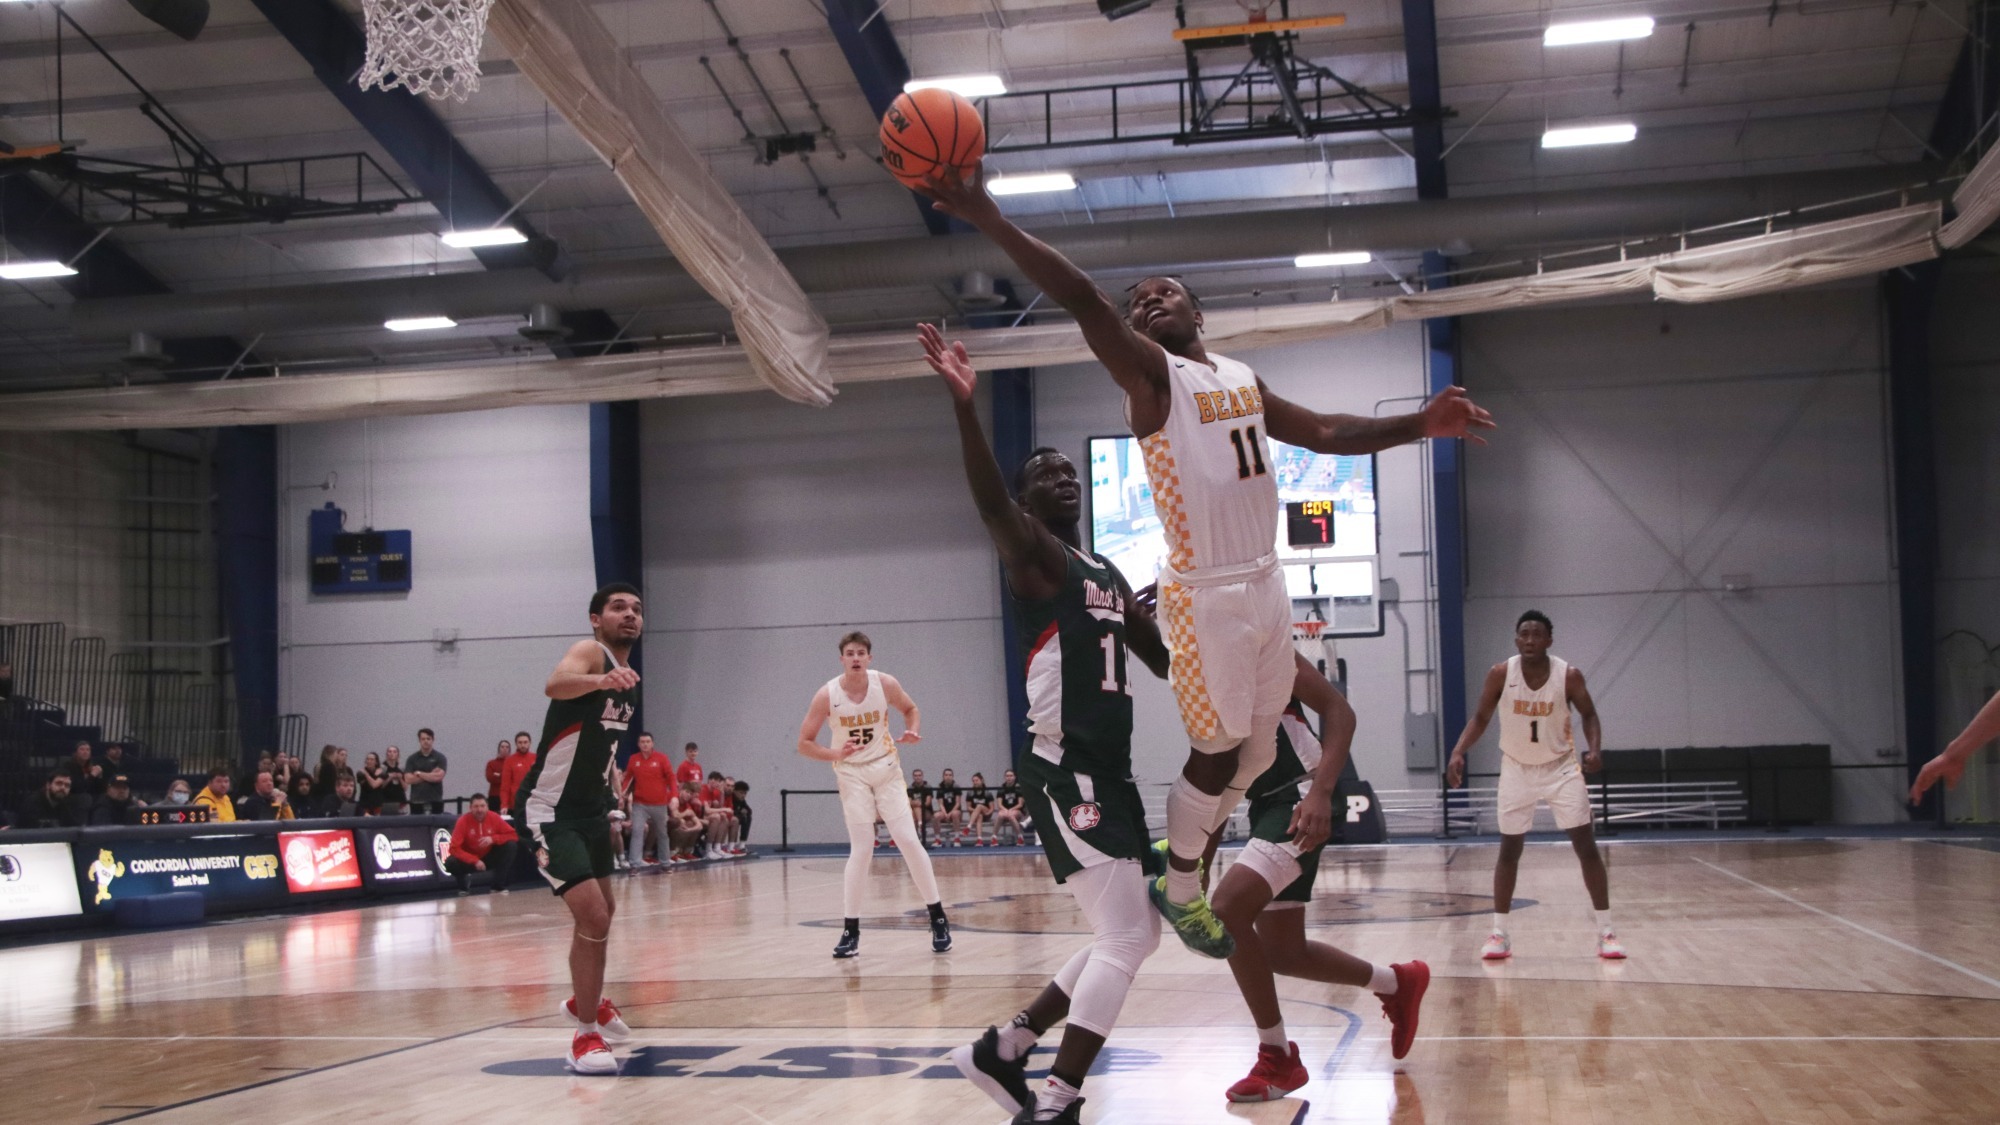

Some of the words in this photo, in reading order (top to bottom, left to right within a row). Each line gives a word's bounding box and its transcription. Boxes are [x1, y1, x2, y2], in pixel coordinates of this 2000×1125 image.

[1194, 386, 1264, 424] BEARS
[1229, 424, 1267, 480] 11
[1302, 501, 1332, 515] 1:09
[1311, 518, 1328, 543] 7
[1513, 700, 1554, 717] BEARS
[840, 710, 880, 728] BEARS
[849, 728, 874, 745] 55
[1530, 720, 1539, 743] 1
[130, 857, 190, 874] CONCORDIA
[190, 856, 241, 870] UNIVERSITY
[243, 854, 279, 880] CSP
[172, 873, 194, 887] Saint
[192, 872, 210, 886] Paul
